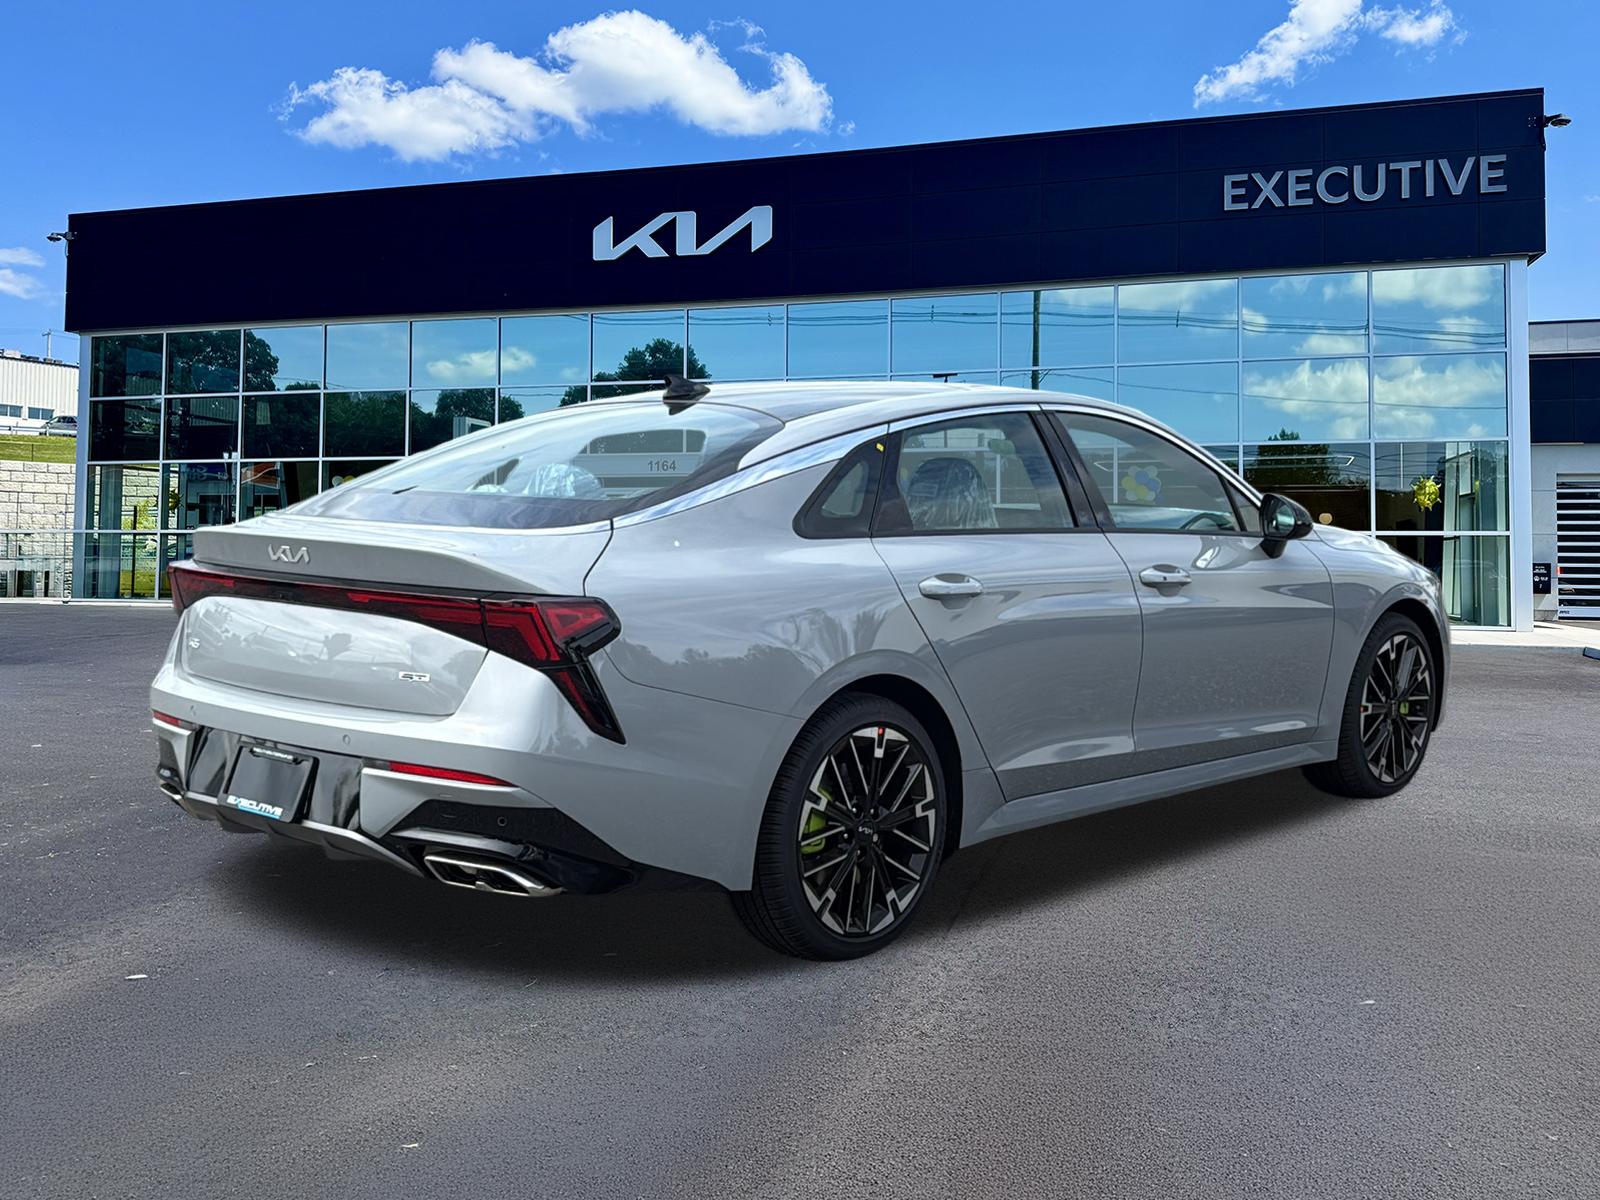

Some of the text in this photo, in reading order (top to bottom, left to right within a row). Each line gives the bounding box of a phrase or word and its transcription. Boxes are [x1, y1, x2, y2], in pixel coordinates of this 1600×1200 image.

[1224, 154, 1508, 211] EXECUTIVE
[593, 205, 772, 261] KIA
[647, 460, 677, 472] 1164
[268, 544, 309, 564] KIA
